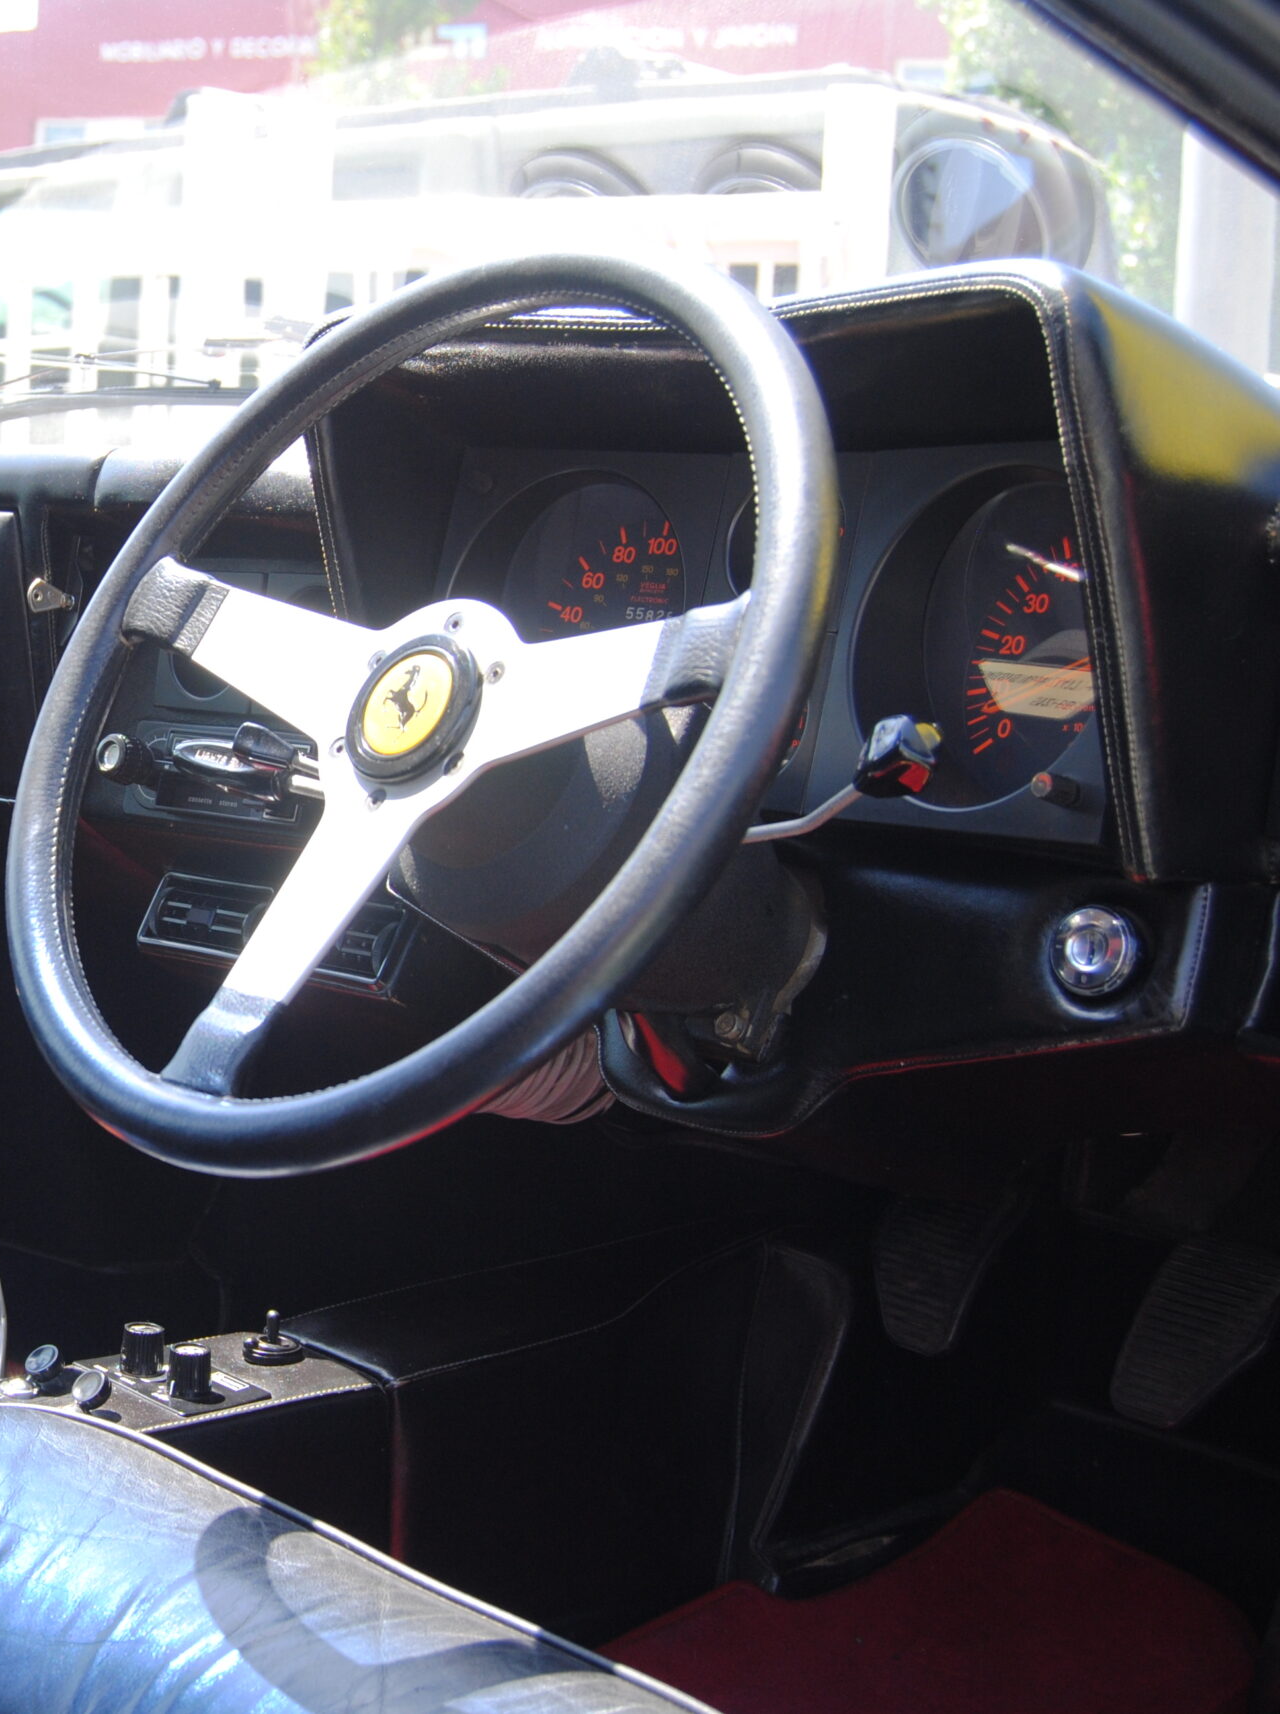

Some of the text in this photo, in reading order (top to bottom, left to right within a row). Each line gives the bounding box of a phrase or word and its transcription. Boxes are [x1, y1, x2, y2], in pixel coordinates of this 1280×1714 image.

[612, 546, 636, 564] 80
[647, 537, 679, 555] 100
[581, 572, 605, 589] 60
[1023, 594, 1050, 613] 30
[560, 606, 583, 624] 40
[999, 635, 1025, 655] 20
[997, 718, 1012, 739] 0
